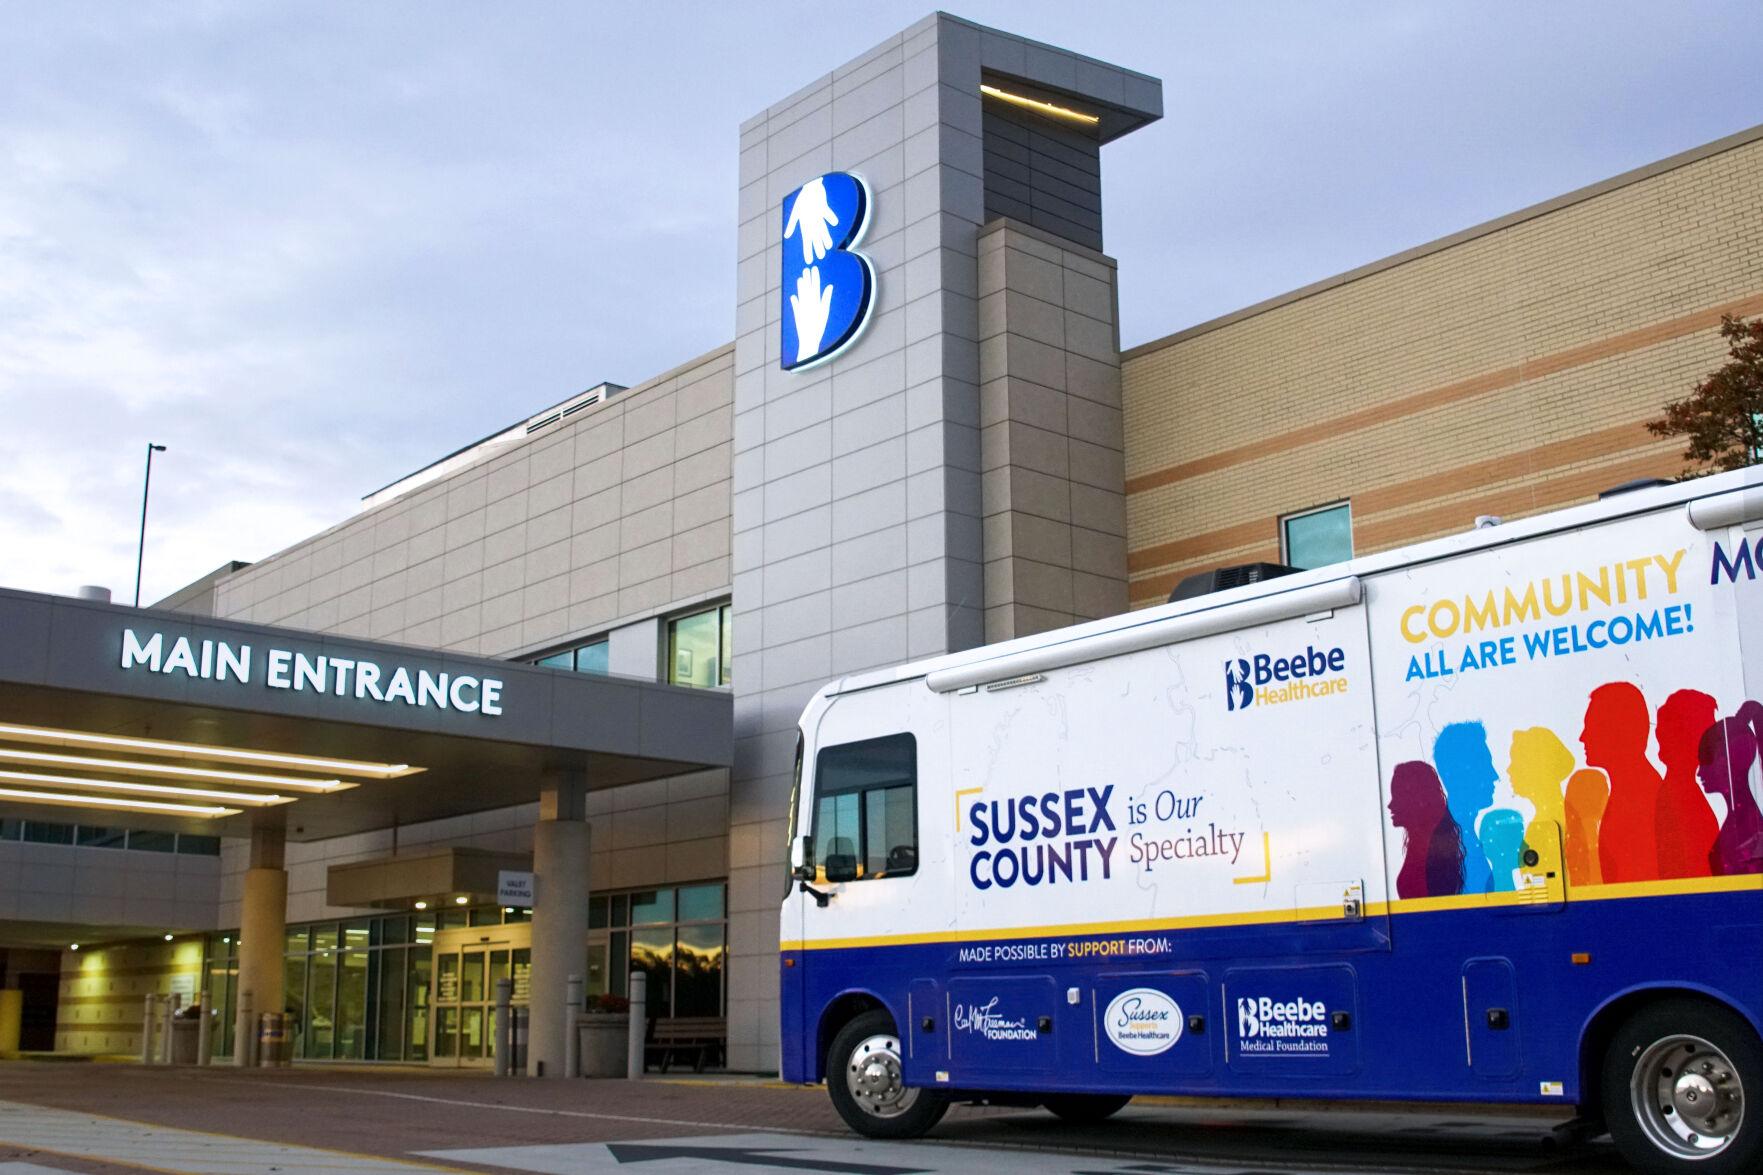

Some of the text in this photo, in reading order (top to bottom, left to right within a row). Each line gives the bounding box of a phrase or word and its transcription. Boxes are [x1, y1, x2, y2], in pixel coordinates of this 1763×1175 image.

[1711, 536, 1763, 585] M
[1400, 548, 1687, 643] COMMUNITY
[1405, 603, 1695, 682] ALL ARE WELCOME!
[121, 628, 503, 716] MAIN ENTRANCE
[1253, 645, 1345, 686] Beebe
[1255, 677, 1348, 707] Healthcare
[969, 784, 1204, 847] SUSSEX is Our
[969, 823, 1245, 890] COUNTY Specialty
[959, 937, 1172, 962] MADE POSSIBLE BY SUPPORT FROM:
[1118, 997, 1169, 1028] Sussex
[1258, 996, 1326, 1022] Beebe
[987, 1029, 1037, 1040] FOUNDATION
[1118, 1031, 1170, 1040] Beebe Healthcare
[1240, 1039, 1328, 1051] Medical Foundation
[1259, 1021, 1328, 1038] Healthcare
